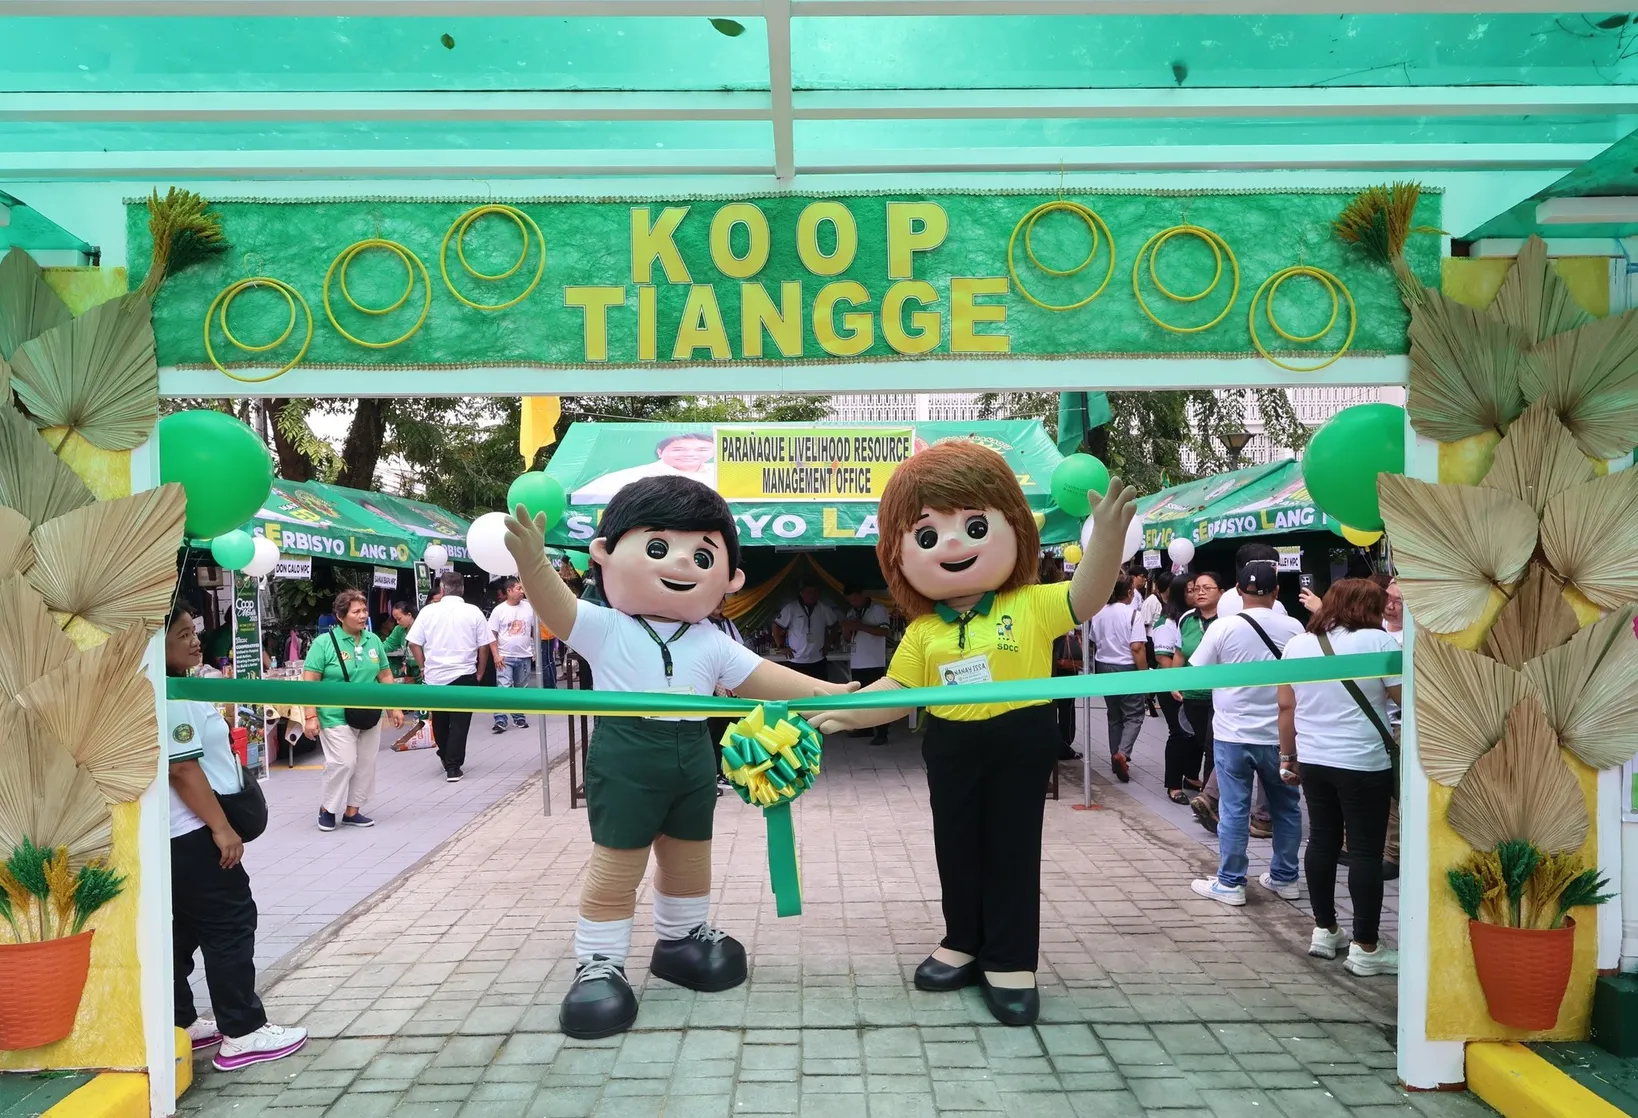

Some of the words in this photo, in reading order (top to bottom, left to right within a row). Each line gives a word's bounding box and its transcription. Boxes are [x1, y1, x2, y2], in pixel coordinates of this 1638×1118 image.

[630, 201, 949, 284] KOOP
[564, 277, 1011, 362] TIANGGE
[722, 431, 785, 463] PARAÑAQUE
[788, 436, 850, 462] LIVELIHOOD
[854, 436, 909, 462] RESOURCE
[762, 468, 833, 494] MANAGEMENT
[836, 468, 871, 494] OFFICE
[1260, 507, 1316, 530] LANG
[349, 536, 386, 560] LANG
[390, 543, 409, 562] PO
[276, 563, 287, 573] DON
[235, 598, 254, 610] Coop
[997, 643, 1019, 653] SDCC
[954, 666, 972, 676] NANAY
[972, 663, 987, 672] ISSA
